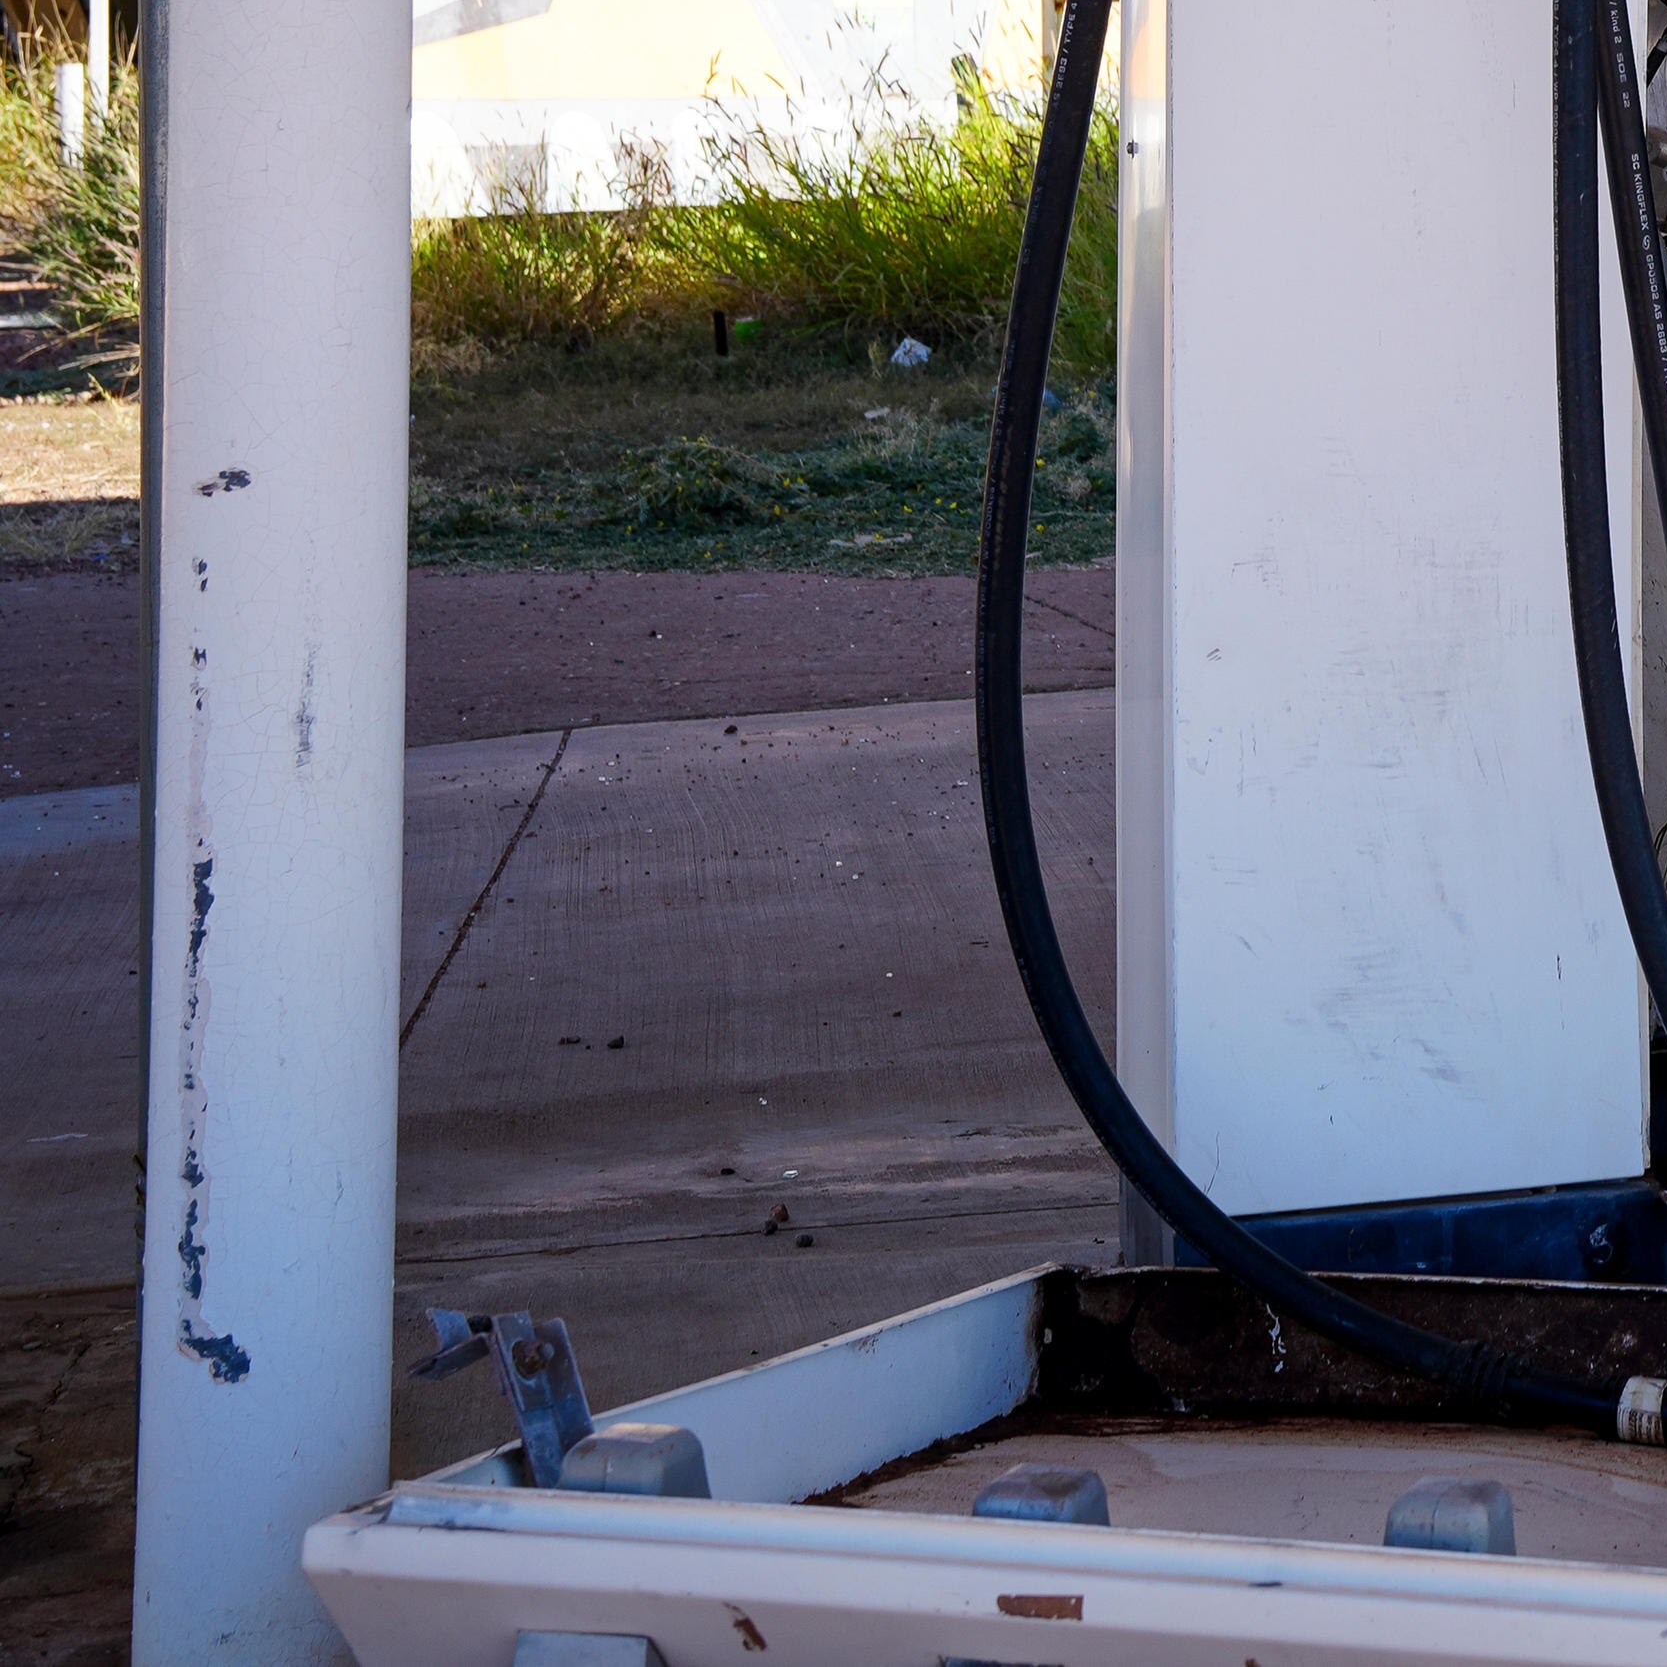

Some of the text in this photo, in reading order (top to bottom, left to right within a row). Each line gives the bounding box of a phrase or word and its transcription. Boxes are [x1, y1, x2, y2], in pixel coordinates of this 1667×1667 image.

[1610, 9, 1621, 34] kind
[1616, 52, 1627, 83] SOE
[1622, 92, 1630, 110] 22
[1631, 153, 1640, 171] SC
[1634, 173, 1649, 231] KINGFLEX
[1646, 254, 1660, 301] GP0502
[1653, 303, 1663, 320] AS
[1656, 322, 1667, 354] 2683
